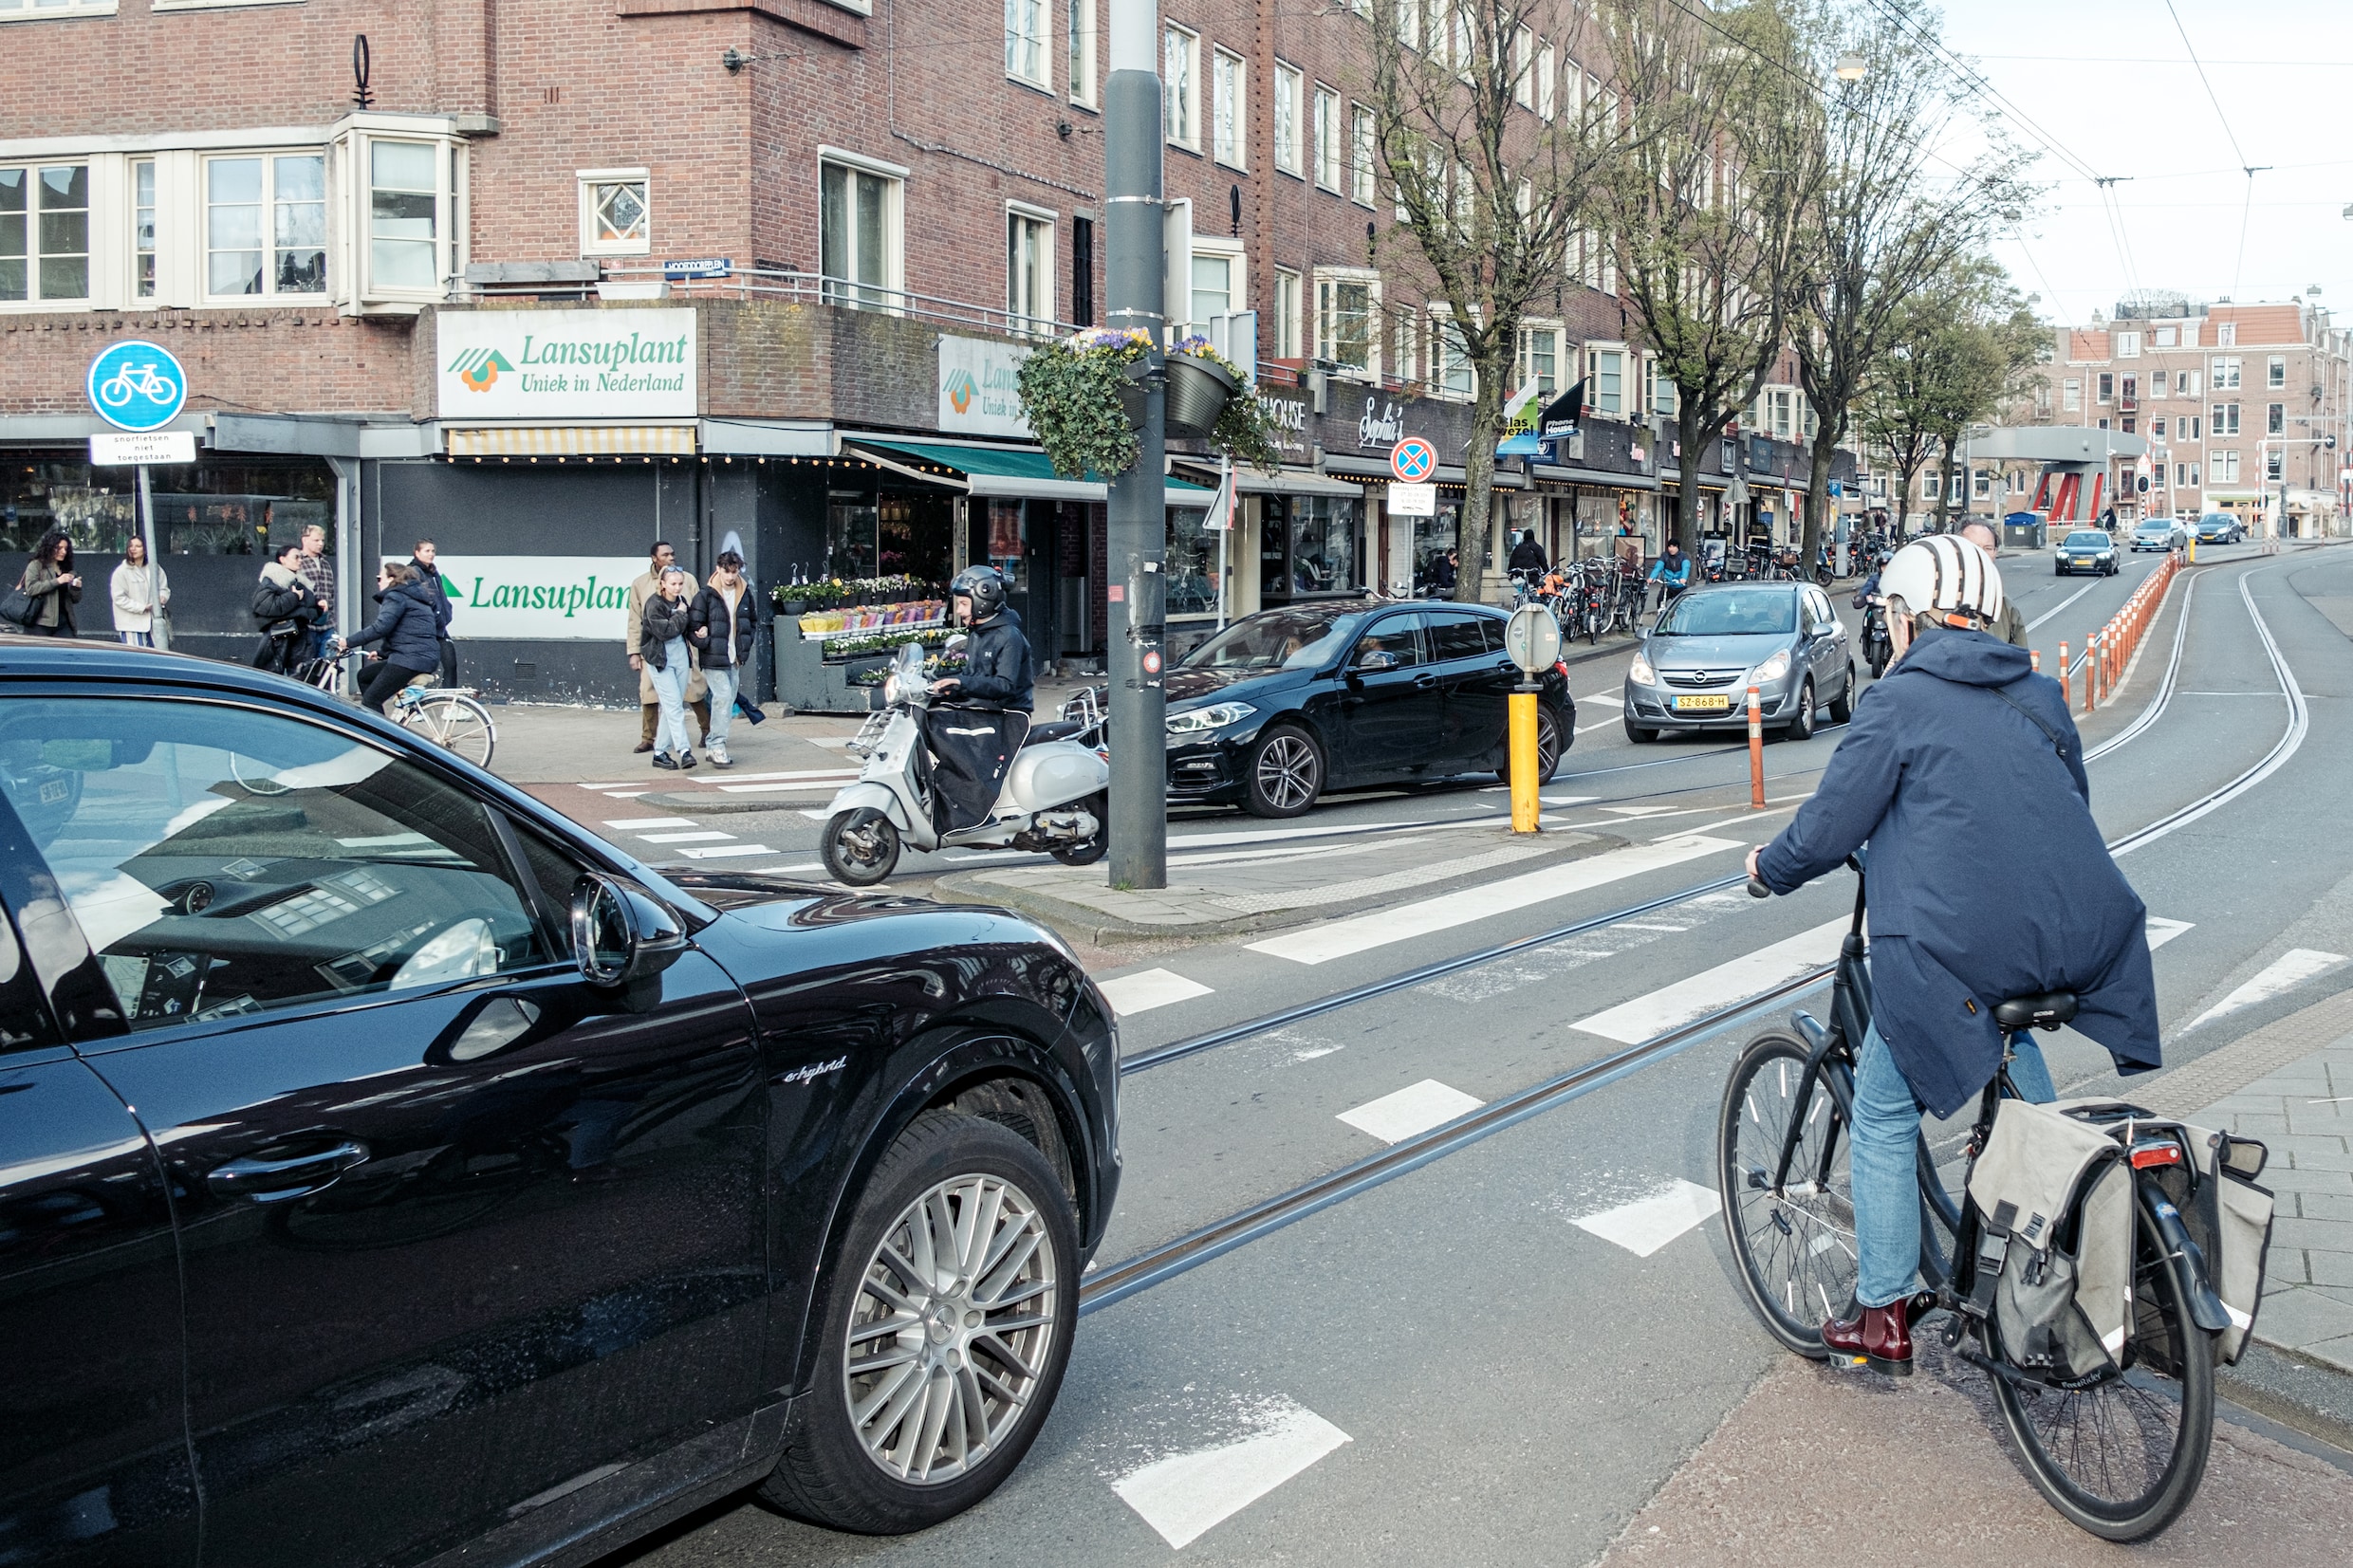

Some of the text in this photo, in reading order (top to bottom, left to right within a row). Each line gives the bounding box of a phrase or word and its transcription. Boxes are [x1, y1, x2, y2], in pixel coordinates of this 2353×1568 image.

[520, 332, 688, 372] Lansuplant
[522, 373, 685, 392] Uniek in Nederland
[982, 397, 1007, 416] Uniek
[118, 453, 172, 462] toegestaan
[470, 575, 632, 618] Lansuplan
[1679, 697, 1725, 707] SZ-868-H
